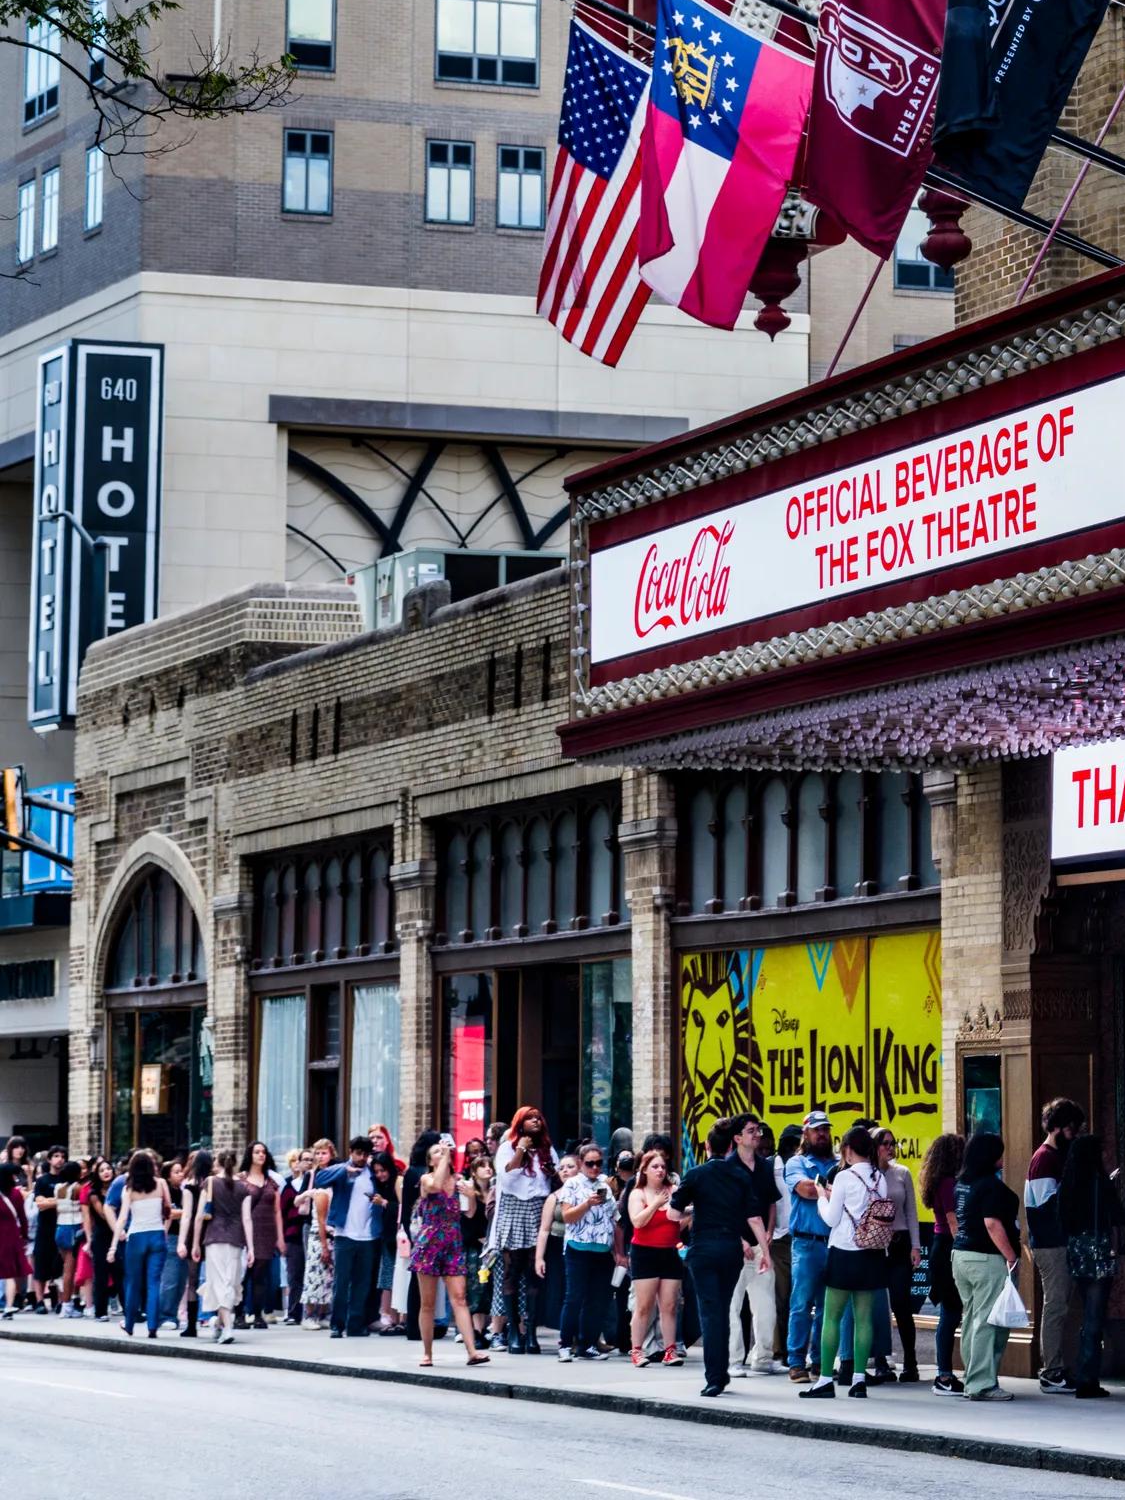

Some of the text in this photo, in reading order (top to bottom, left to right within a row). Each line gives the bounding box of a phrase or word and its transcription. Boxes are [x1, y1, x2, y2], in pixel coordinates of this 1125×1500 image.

[828, 16, 892, 80] FOX
[994, 24, 1025, 83] PRESENTED
[1022, 6, 1033, 21] BY
[893, 63, 935, 143] THEATRE
[100, 378, 137, 402] 640
[785, 405, 1075, 540] OFFICIAL BEVERAGE OF
[38, 428, 60, 687] HOTEL
[97, 426, 135, 628] HOTE
[815, 483, 1037, 590] THE FOX THEATRE
[634, 520, 734, 639] Coca-Cola
[767, 1048, 805, 1097] THE
